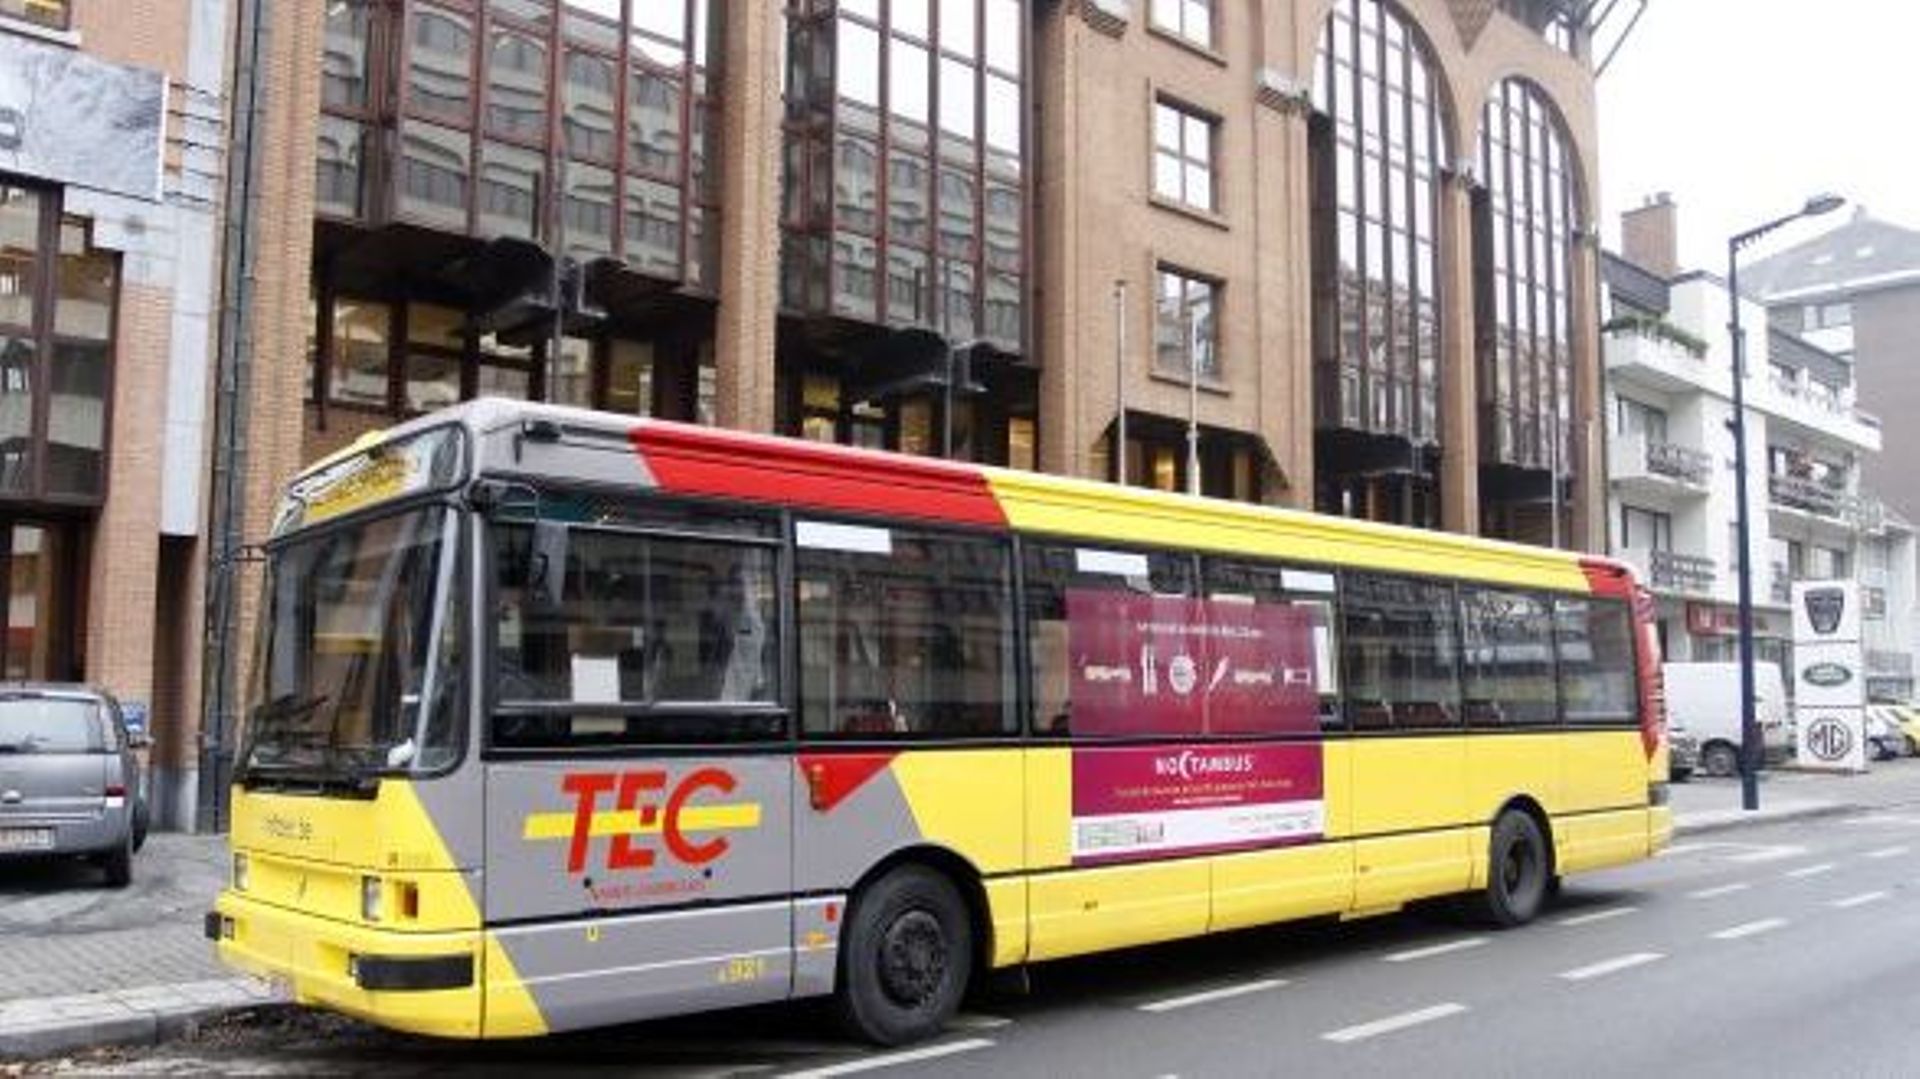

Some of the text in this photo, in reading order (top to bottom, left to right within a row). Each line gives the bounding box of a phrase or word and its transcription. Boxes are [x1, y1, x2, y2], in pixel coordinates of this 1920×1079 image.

[1811, 724, 1846, 755] MG
[1155, 751, 1254, 779] NOCTAMBUS
[563, 767, 736, 873] TEC
